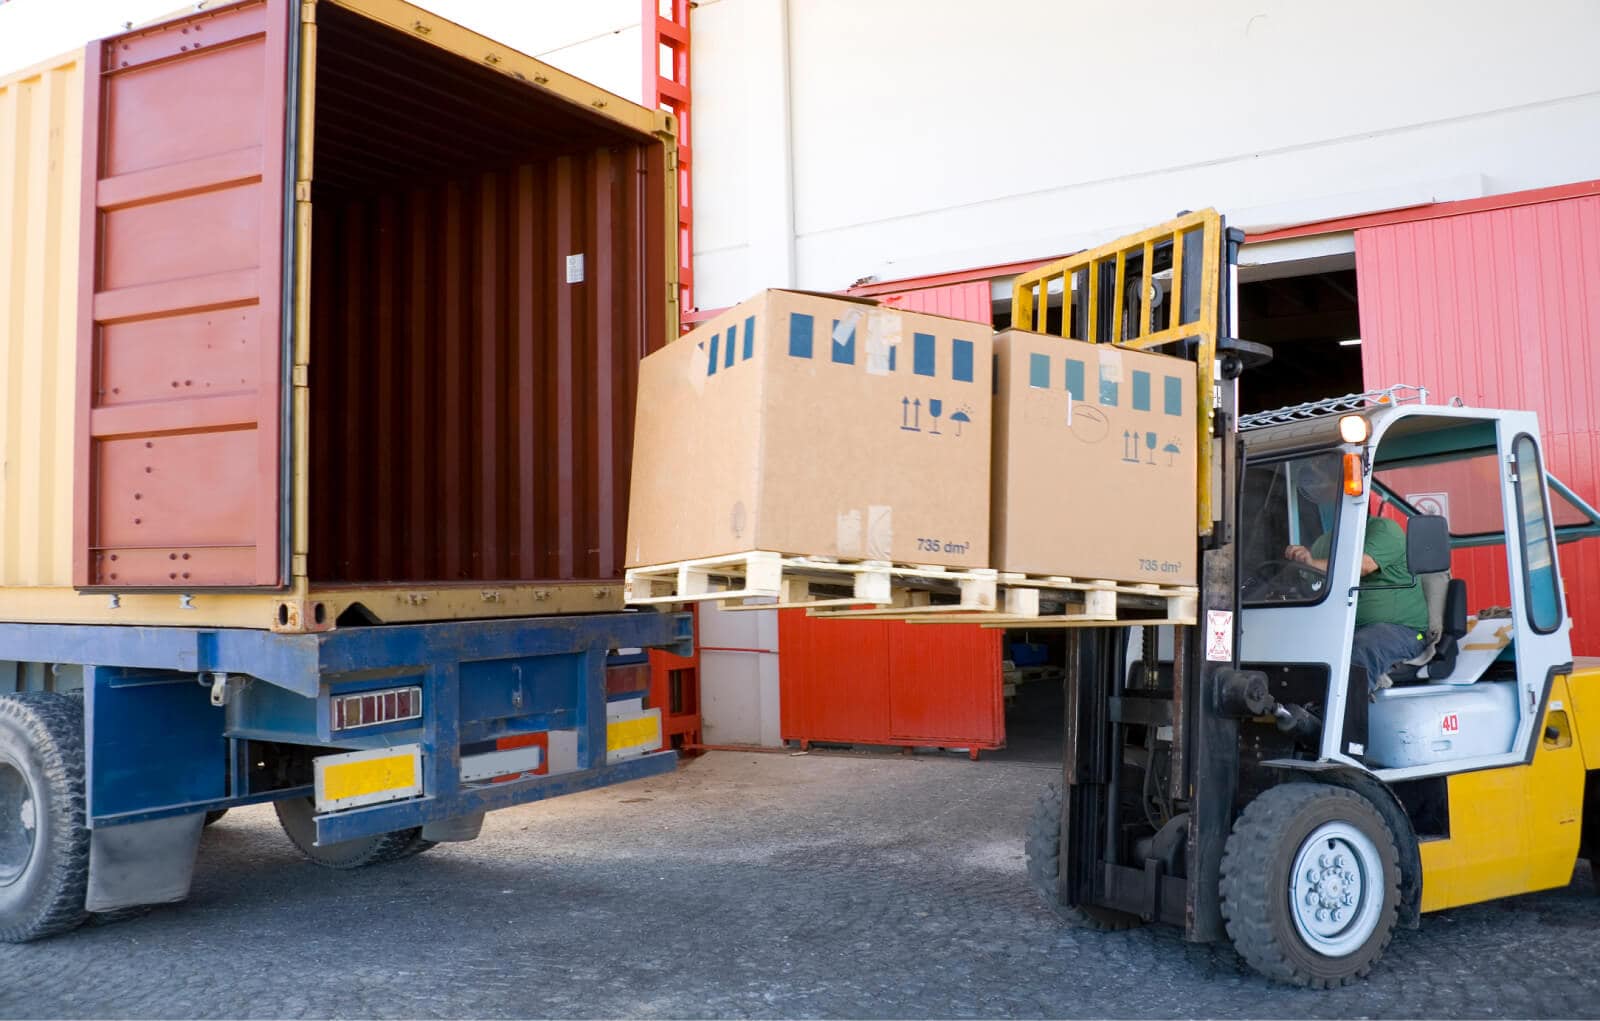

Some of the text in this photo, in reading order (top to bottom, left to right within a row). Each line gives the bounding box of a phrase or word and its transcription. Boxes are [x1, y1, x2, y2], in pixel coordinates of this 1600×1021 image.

[917, 538, 941, 552] 735
[1138, 559, 1158, 571] 735
[1442, 715, 1458, 731] 40
